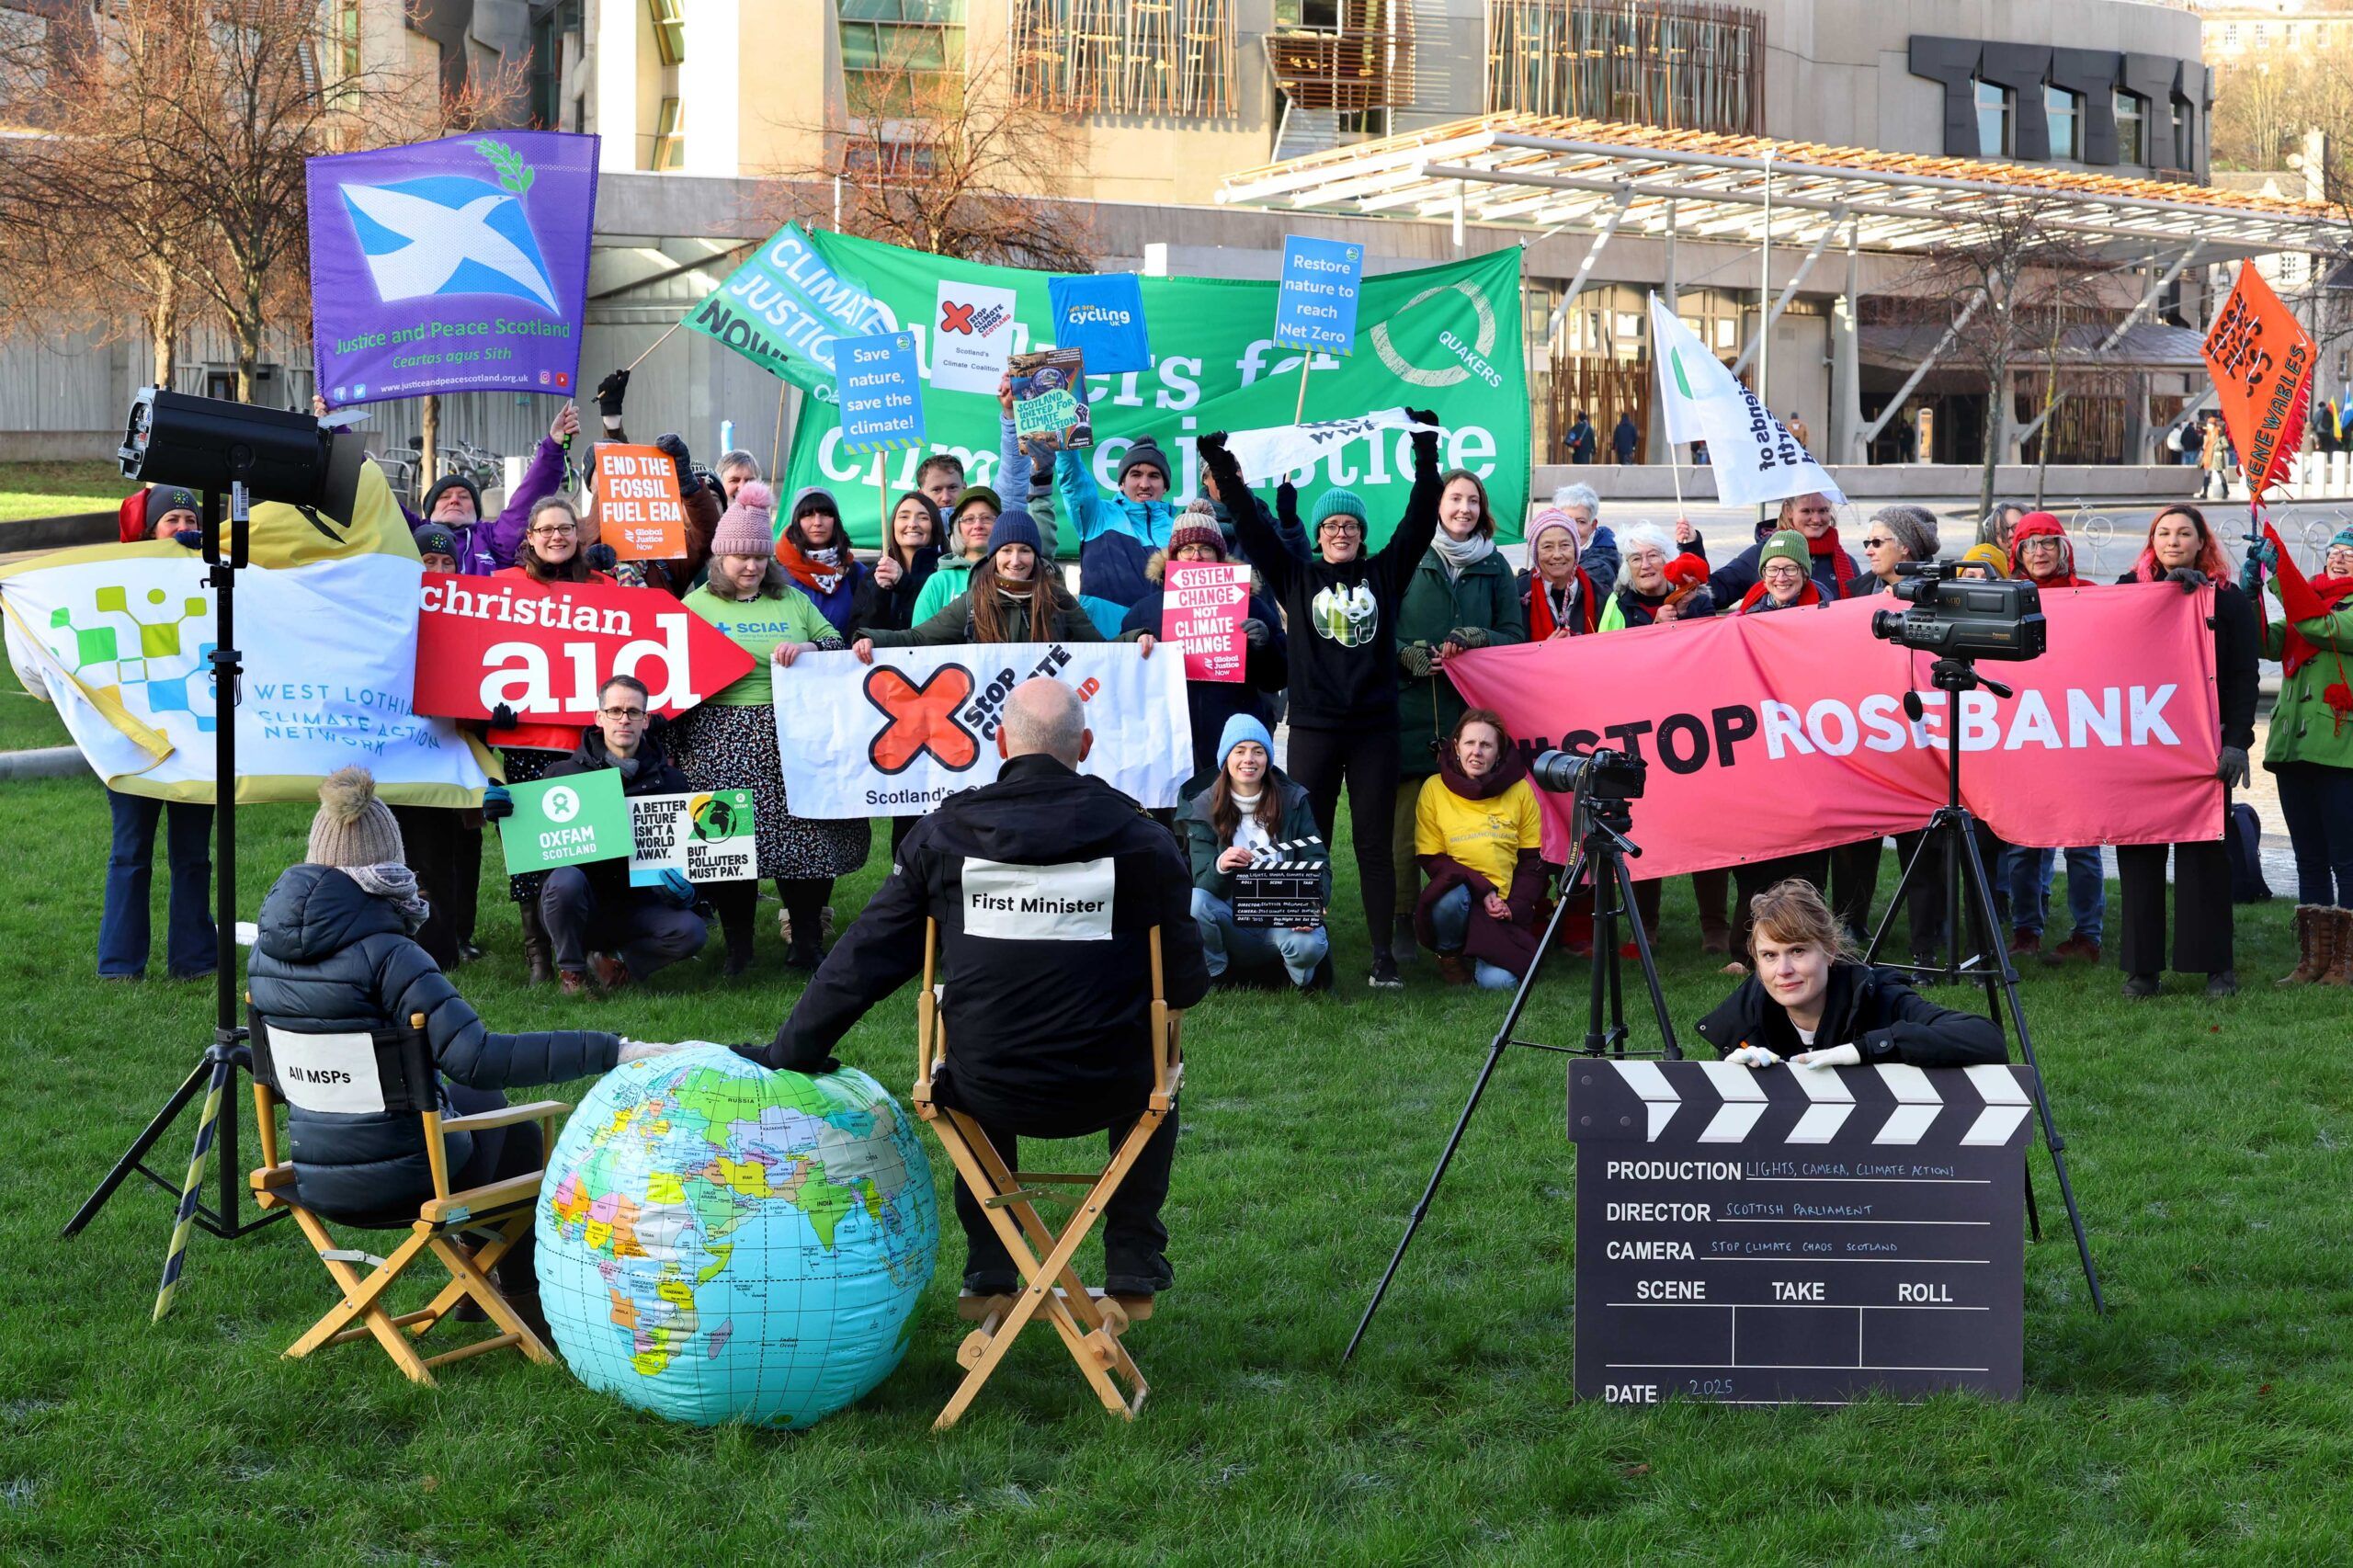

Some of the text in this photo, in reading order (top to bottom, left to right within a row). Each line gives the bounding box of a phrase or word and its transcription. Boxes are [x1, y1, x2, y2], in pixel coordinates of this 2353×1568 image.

[1293, 255, 1350, 274] Restore
[770, 238, 893, 336] CLIMATE
[1285, 279, 1354, 298] nature to
[1069, 307, 1131, 325] cycling
[1296, 304, 1337, 319] reach
[731, 274, 836, 372] JUSTIC
[981, 313, 1011, 338] SCOTLAND
[335, 318, 570, 355] Justice and Peace Scotland
[1279, 323, 1346, 343] Net Zero
[392, 351, 442, 369] Ceartas
[446, 349, 481, 365] agus
[853, 348, 890, 363] Save
[956, 347, 989, 358] Scotland's
[1438, 330, 1502, 388] QUAKERS
[943, 359, 1000, 372] Climate Coalition
[381, 373, 529, 393] www.justiceandpeacescotland.org.uk
[848, 371, 904, 387] nature,
[847, 392, 913, 412] save the
[1017, 392, 1063, 413] SCOTLAND
[1019, 399, 1074, 419] UNITED FOR
[849, 415, 915, 435] climate!
[1020, 412, 1059, 431] CLIMATE
[1044, 415, 1077, 432] ACTION
[2245, 343, 2307, 493] RENEWABLES
[603, 456, 671, 476] END THE
[609, 479, 671, 498] FOSSIL
[602, 501, 681, 522] FUEL ERA
[1181, 567, 1234, 586] SYSTEM
[1178, 587, 1233, 607] CHANGE
[419, 580, 632, 637] christian
[1193, 607, 1219, 619] NOT
[736, 622, 790, 633] SCIAF
[1175, 617, 1234, 637] CLIMATE
[479, 613, 701, 714] aid
[255, 685, 432, 720] WEST LOTHIA
[258, 710, 441, 750] CLIMATE ACTION
[265, 726, 386, 757] NETWORK
[632, 801, 688, 814] A BETTER
[633, 812, 676, 825] FUTURE
[539, 824, 596, 848] OXFAM
[634, 824, 675, 837] ISN'T A
[542, 843, 597, 861] SCOTLAND
[634, 836, 675, 849] WORLD
[688, 846, 708, 857] BUT
[636, 848, 671, 860] AWAY.
[688, 854, 748, 869] POLLUTERS
[1568, 841, 1578, 867] Nikon
[688, 866, 744, 879] MUST PAY.
[972, 893, 1105, 914] First Minister
[289, 1066, 351, 1084] All MSPs
[1606, 1161, 1743, 1181] PRODUCTION
[1745, 1162, 1955, 1177] LIGHTS, CAMERA, CLIMATE ACTION!
[1606, 1203, 1711, 1222] DIRECTOR
[1726, 1202, 1873, 1216] SCOTTISH PARLIAMENT
[1606, 1241, 1695, 1261] CAMERA
[1711, 1241, 1898, 1253] STOP CLIMATE CHAOS SCOTLAND
[1636, 1280, 1706, 1300] SCENE
[1772, 1282, 1825, 1301] TAKE
[1898, 1284, 1953, 1302] ROLL
[1605, 1385, 1658, 1404] DATE
[1689, 1379, 1733, 1396] 2025
